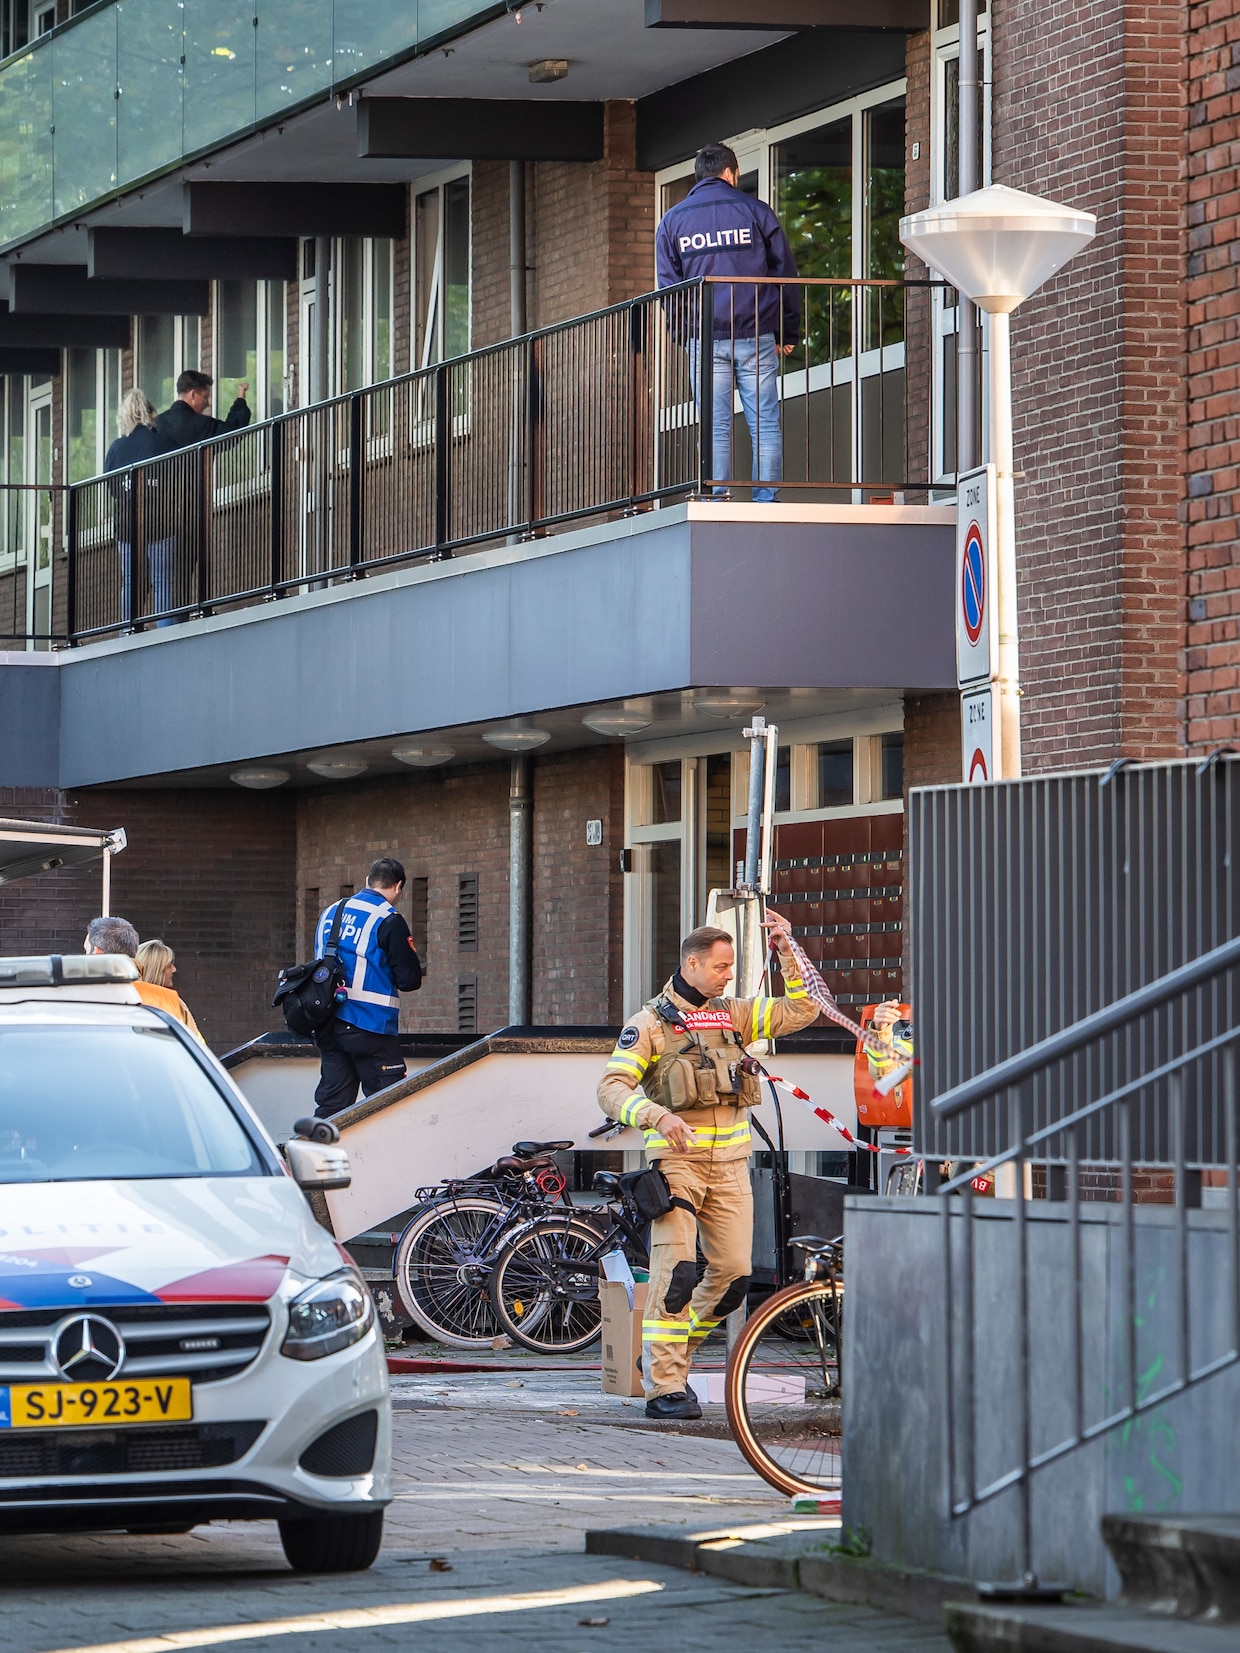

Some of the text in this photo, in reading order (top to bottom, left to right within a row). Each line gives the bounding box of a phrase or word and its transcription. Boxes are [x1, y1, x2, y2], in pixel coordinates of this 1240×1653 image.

[679, 228, 752, 253] POLITIE
[970, 702, 985, 724] ZONE
[26, 1385, 173, 1420] SJ-923-V
